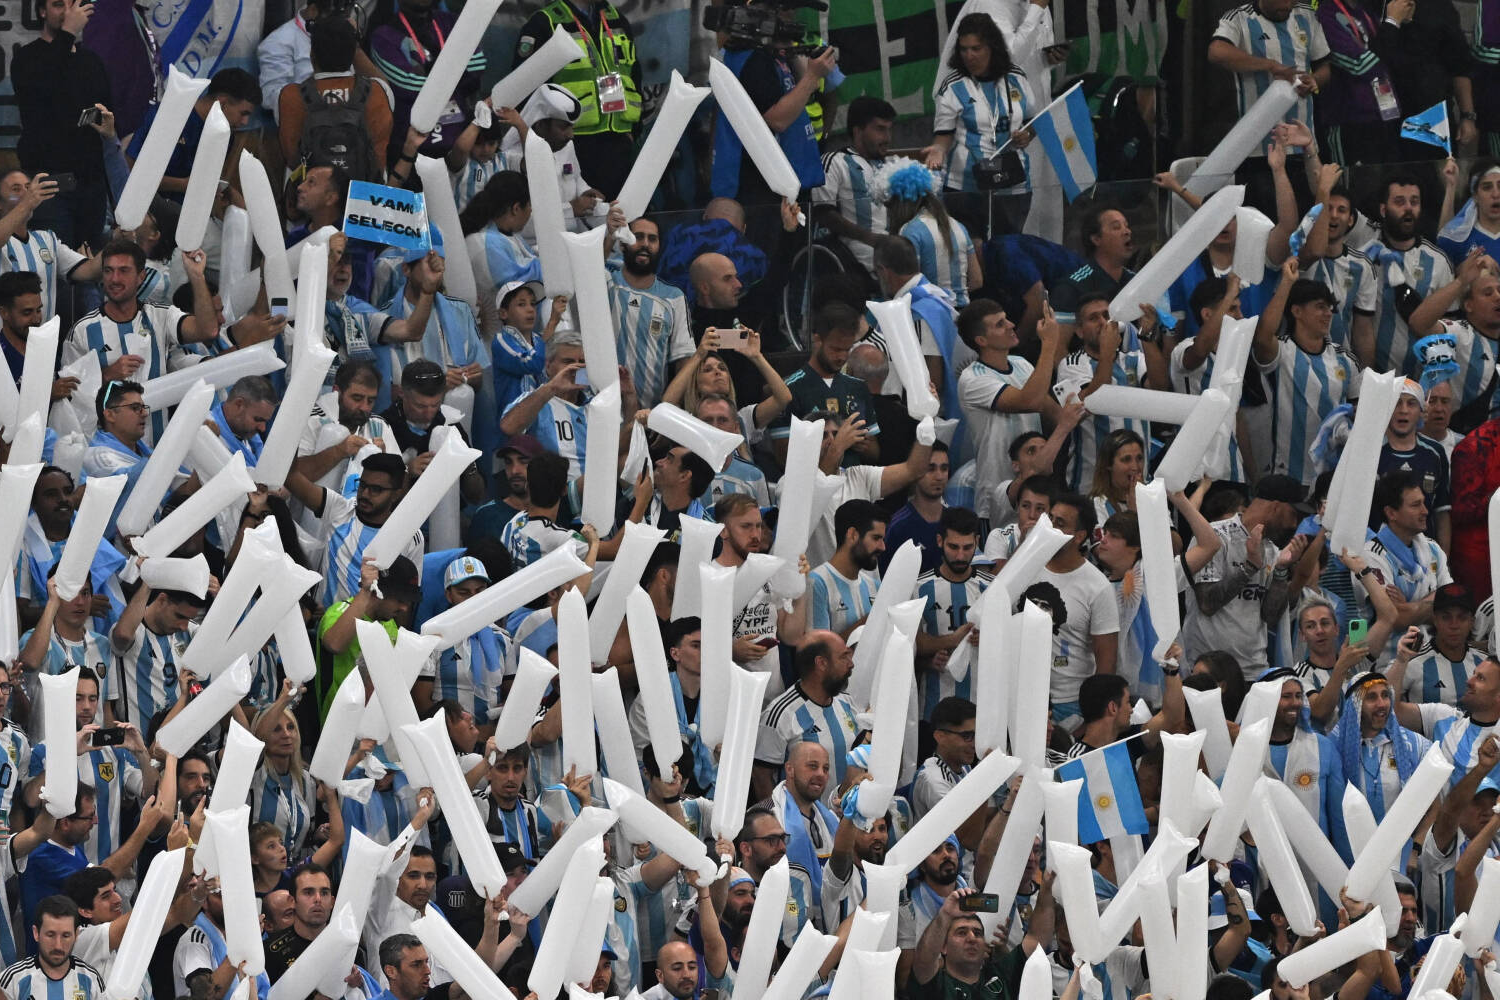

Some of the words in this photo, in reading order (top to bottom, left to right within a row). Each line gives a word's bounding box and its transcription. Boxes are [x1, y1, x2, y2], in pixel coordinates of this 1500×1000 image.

[555, 420, 574, 441] 10
[744, 616, 769, 628] YPF
[163, 663, 178, 687] 9
